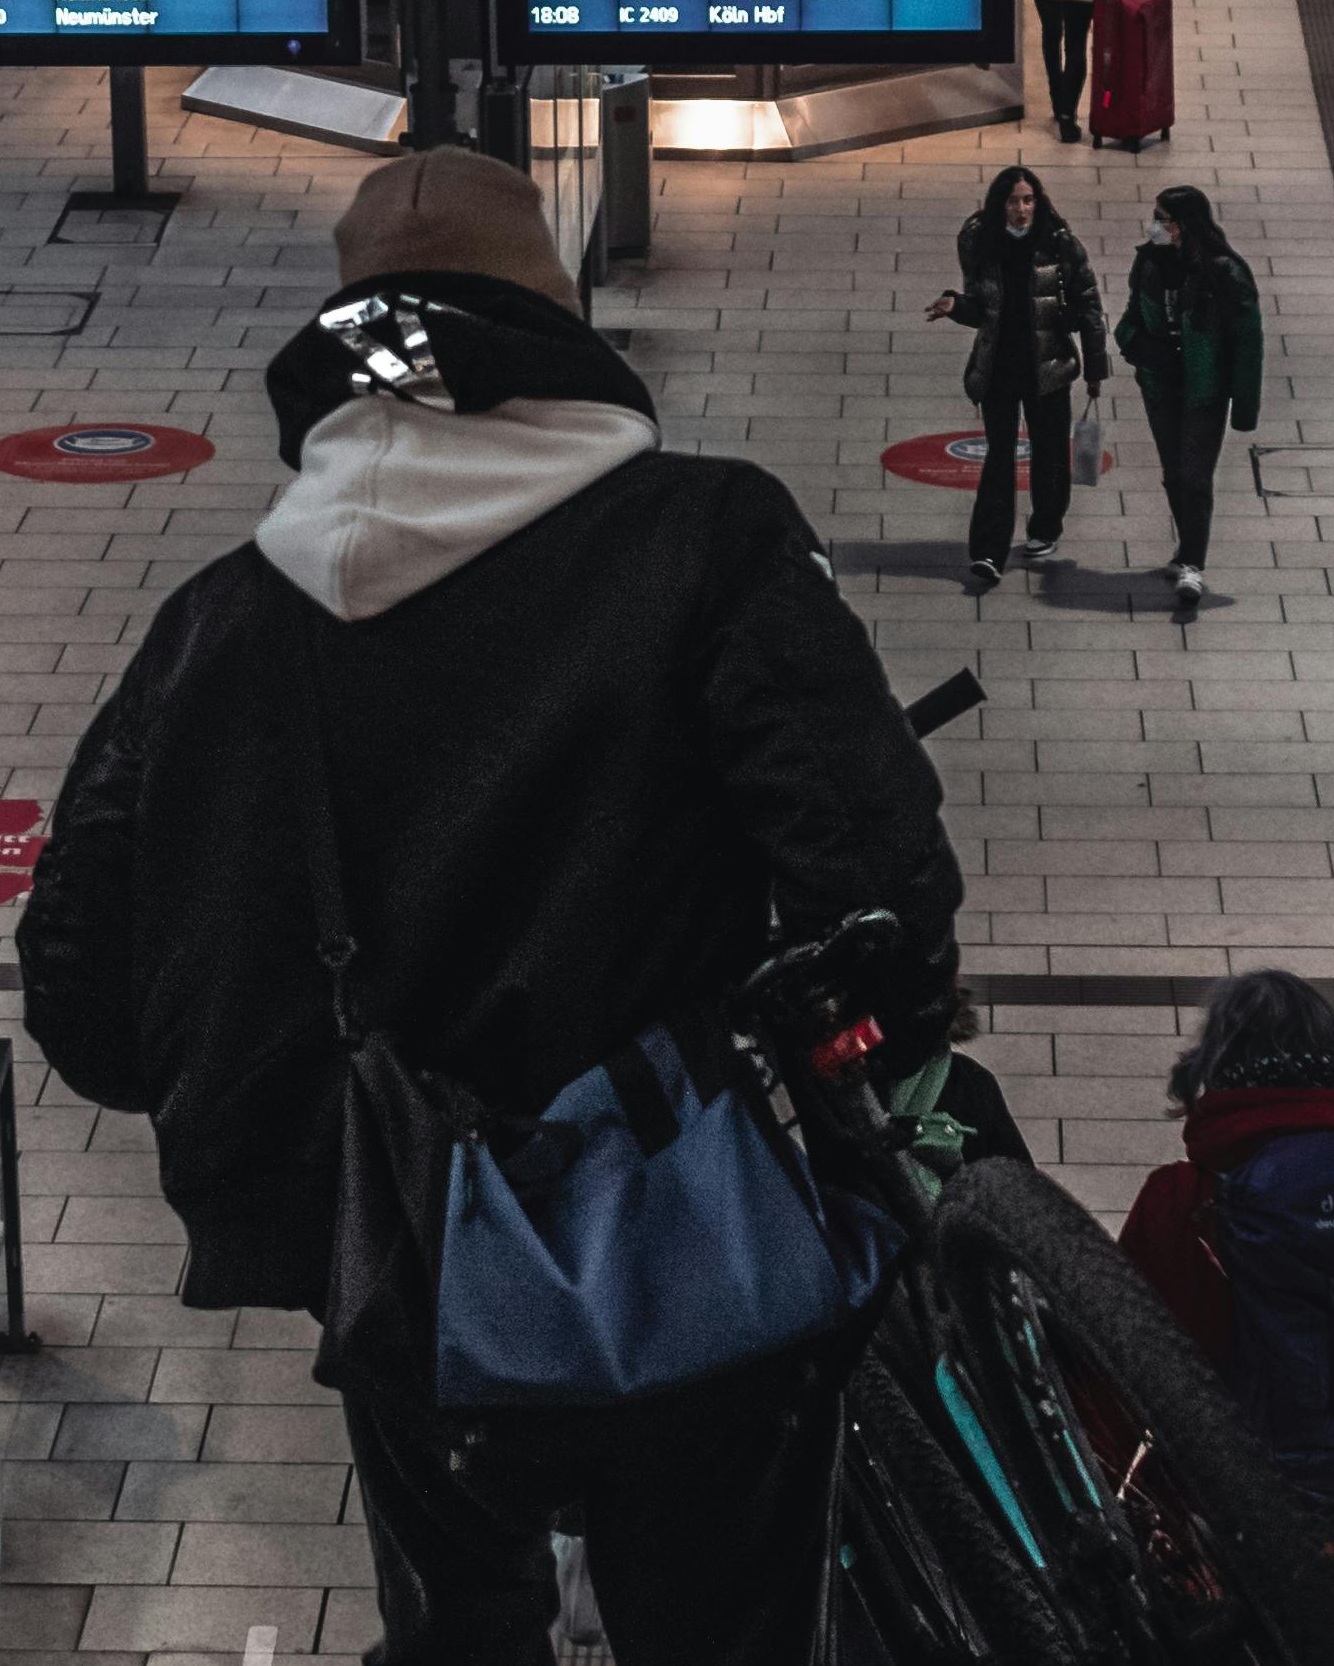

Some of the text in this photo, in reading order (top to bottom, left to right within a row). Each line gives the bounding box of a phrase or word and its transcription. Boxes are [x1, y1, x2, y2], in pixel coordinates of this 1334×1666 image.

[55, 7, 158, 26] Neumünster
[530, 5, 785, 25] 18:08 IC 2409 Köln Hbf
